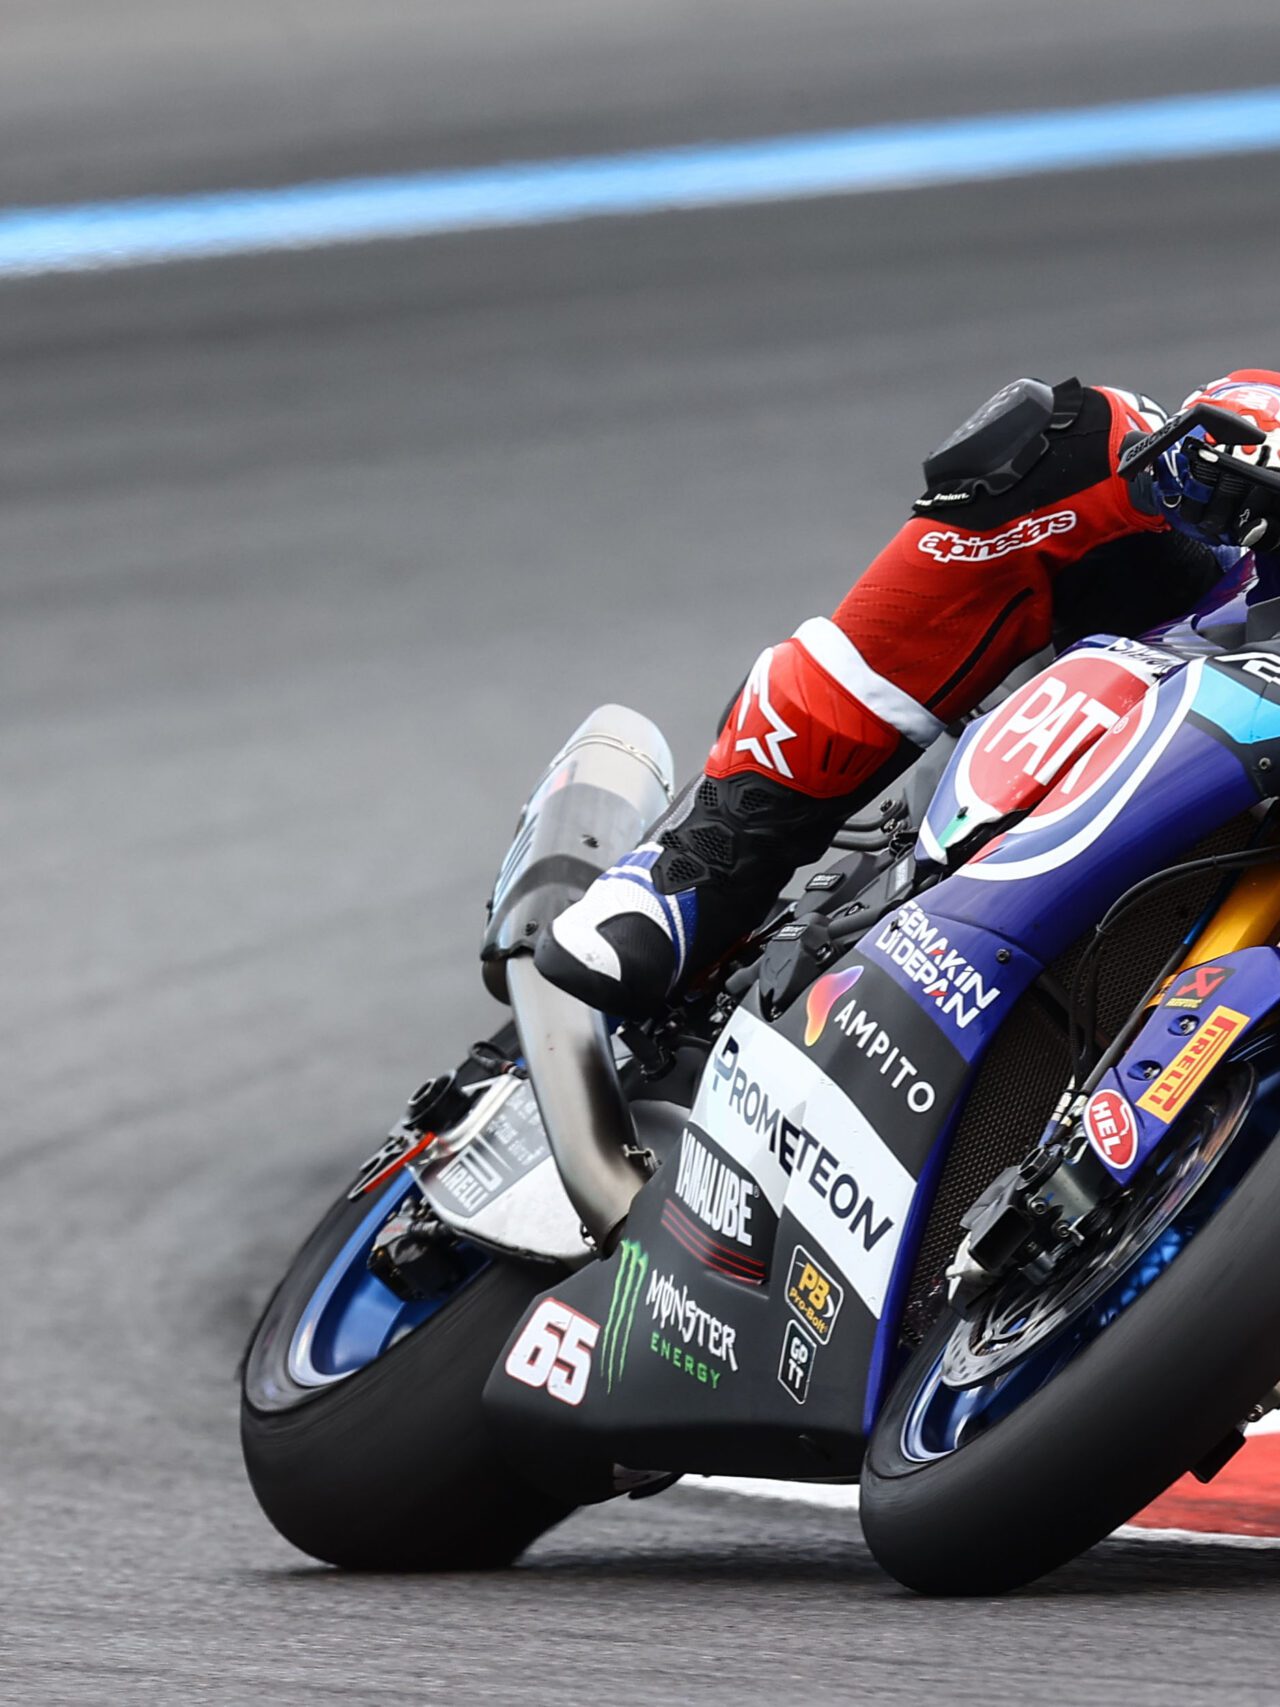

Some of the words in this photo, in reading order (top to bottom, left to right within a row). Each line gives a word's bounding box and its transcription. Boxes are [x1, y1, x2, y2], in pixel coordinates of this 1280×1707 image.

[834, 1000, 936, 1113] AMPITO
[1148, 1014, 1239, 1113] PIRELLI
[713, 1036, 895, 1252] PROMETEON
[1091, 1101, 1121, 1155] HEL
[437, 1147, 503, 1212] PIRELLI
[675, 1127, 754, 1247] YAMALUBE
[789, 1286, 827, 1334] Pro-Bolt
[798, 1262, 831, 1311] PB
[505, 1296, 601, 1406] 65
[650, 1331, 721, 1390] ENERGY
